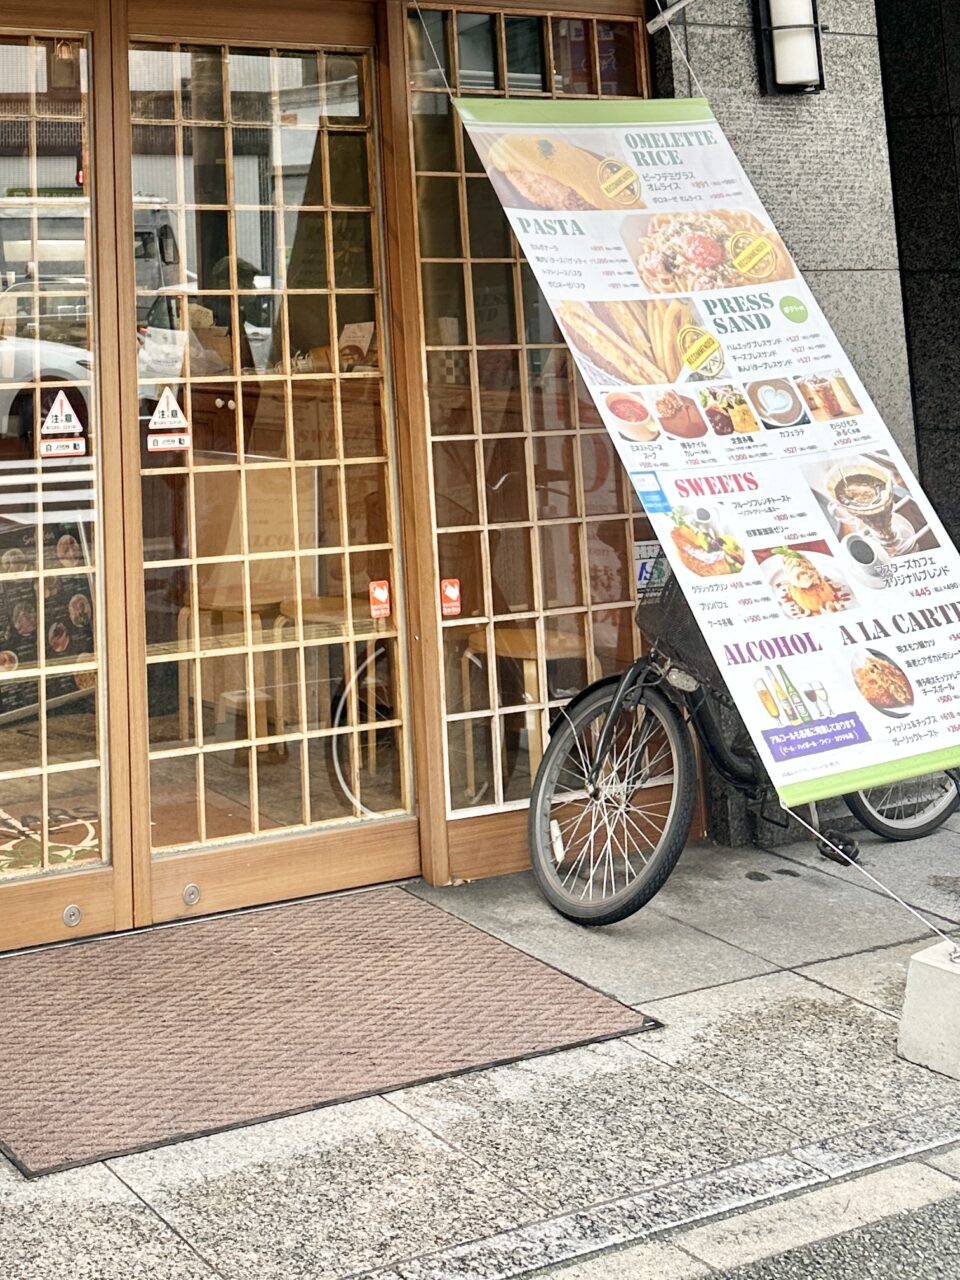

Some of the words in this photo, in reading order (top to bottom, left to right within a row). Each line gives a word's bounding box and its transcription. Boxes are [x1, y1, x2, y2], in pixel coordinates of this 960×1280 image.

[624, 129, 718, 150] OMELETTE
[632, 150, 683, 167] RICE
[646, 182, 681, 192] オムライス
[516, 216, 586, 236] PASTA
[702, 292, 775, 316] PRESS
[712, 313, 772, 335] SAND
[779, 428, 805, 438] カフェラテ
[674, 471, 760, 498] SWEETS
[876, 556, 936, 575] マスターズカフェ
[883, 565, 951, 589] オリジナルブレンド
[910, 586, 932, 598] ¥445
[839, 624, 858, 646] A
[856, 618, 892, 643] LA
[723, 631, 823, 666] ALCOHOL
